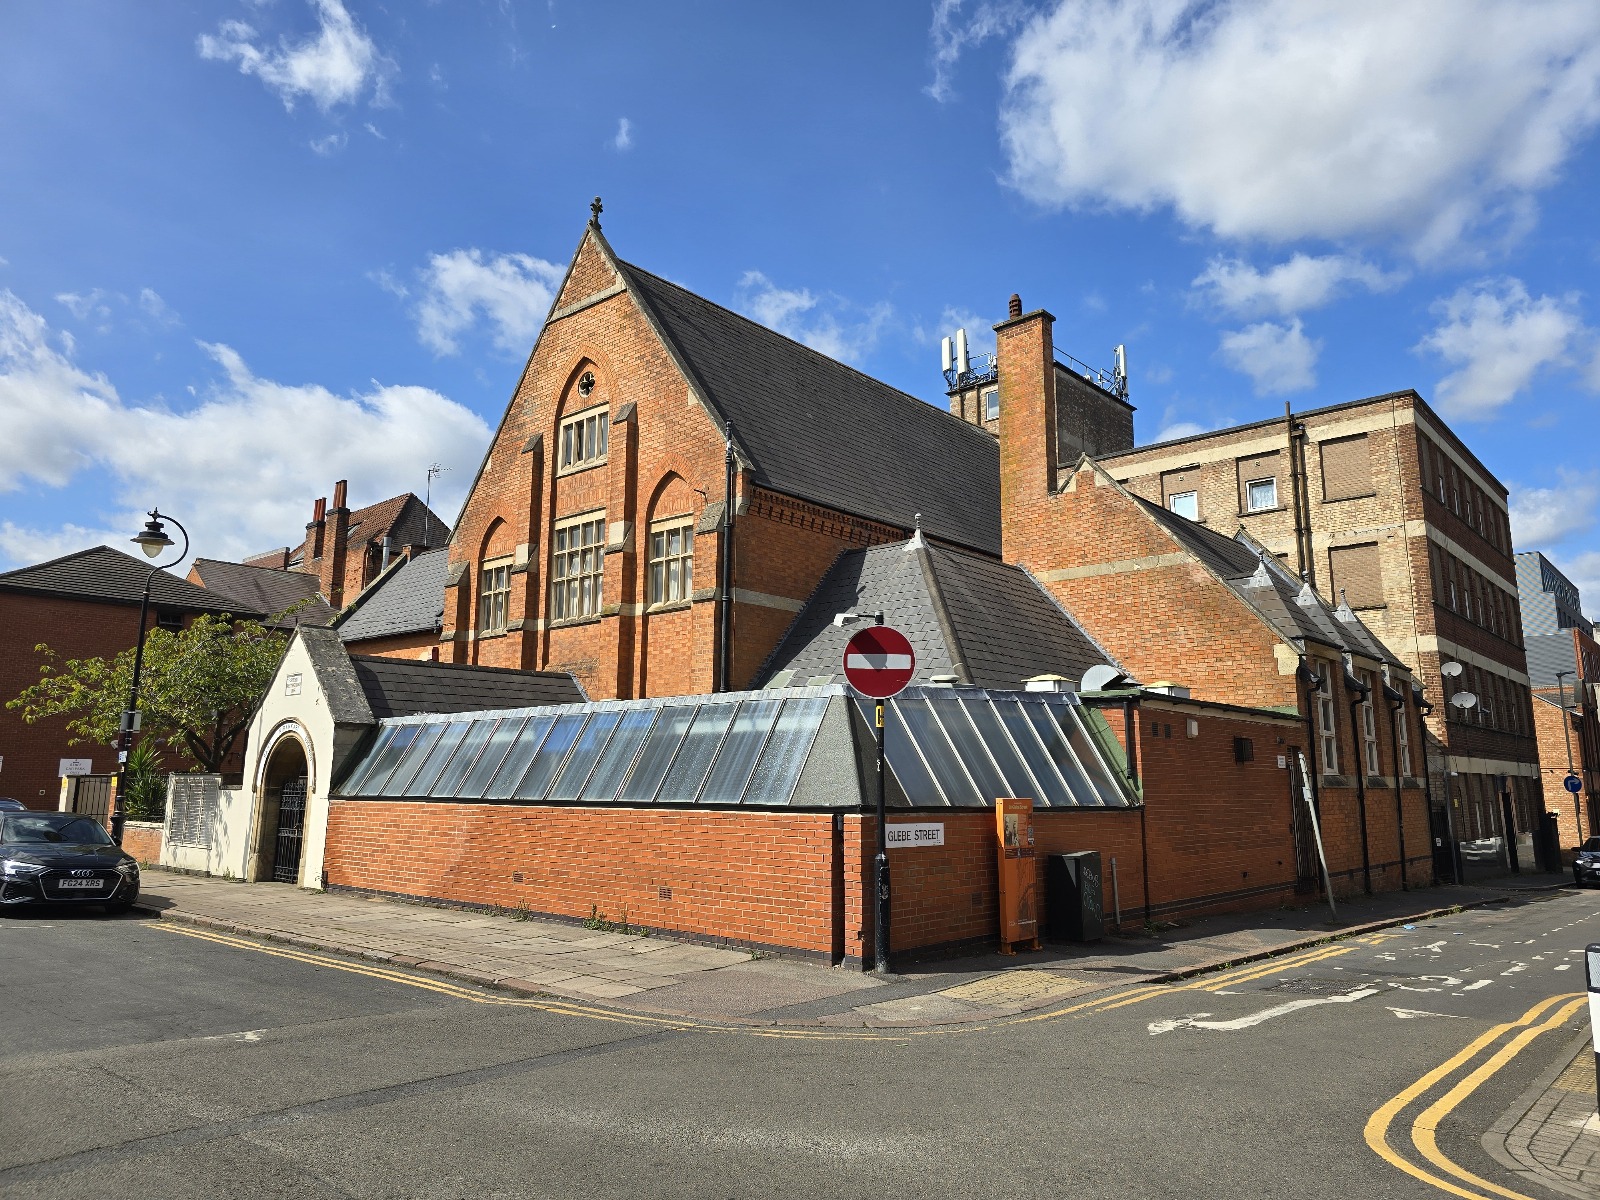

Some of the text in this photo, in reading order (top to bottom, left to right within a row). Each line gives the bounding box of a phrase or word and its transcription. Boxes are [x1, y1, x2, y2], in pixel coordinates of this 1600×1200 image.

[888, 829, 940, 842] GLEBE STREET
[62, 879, 101, 887] FG24 XRS
